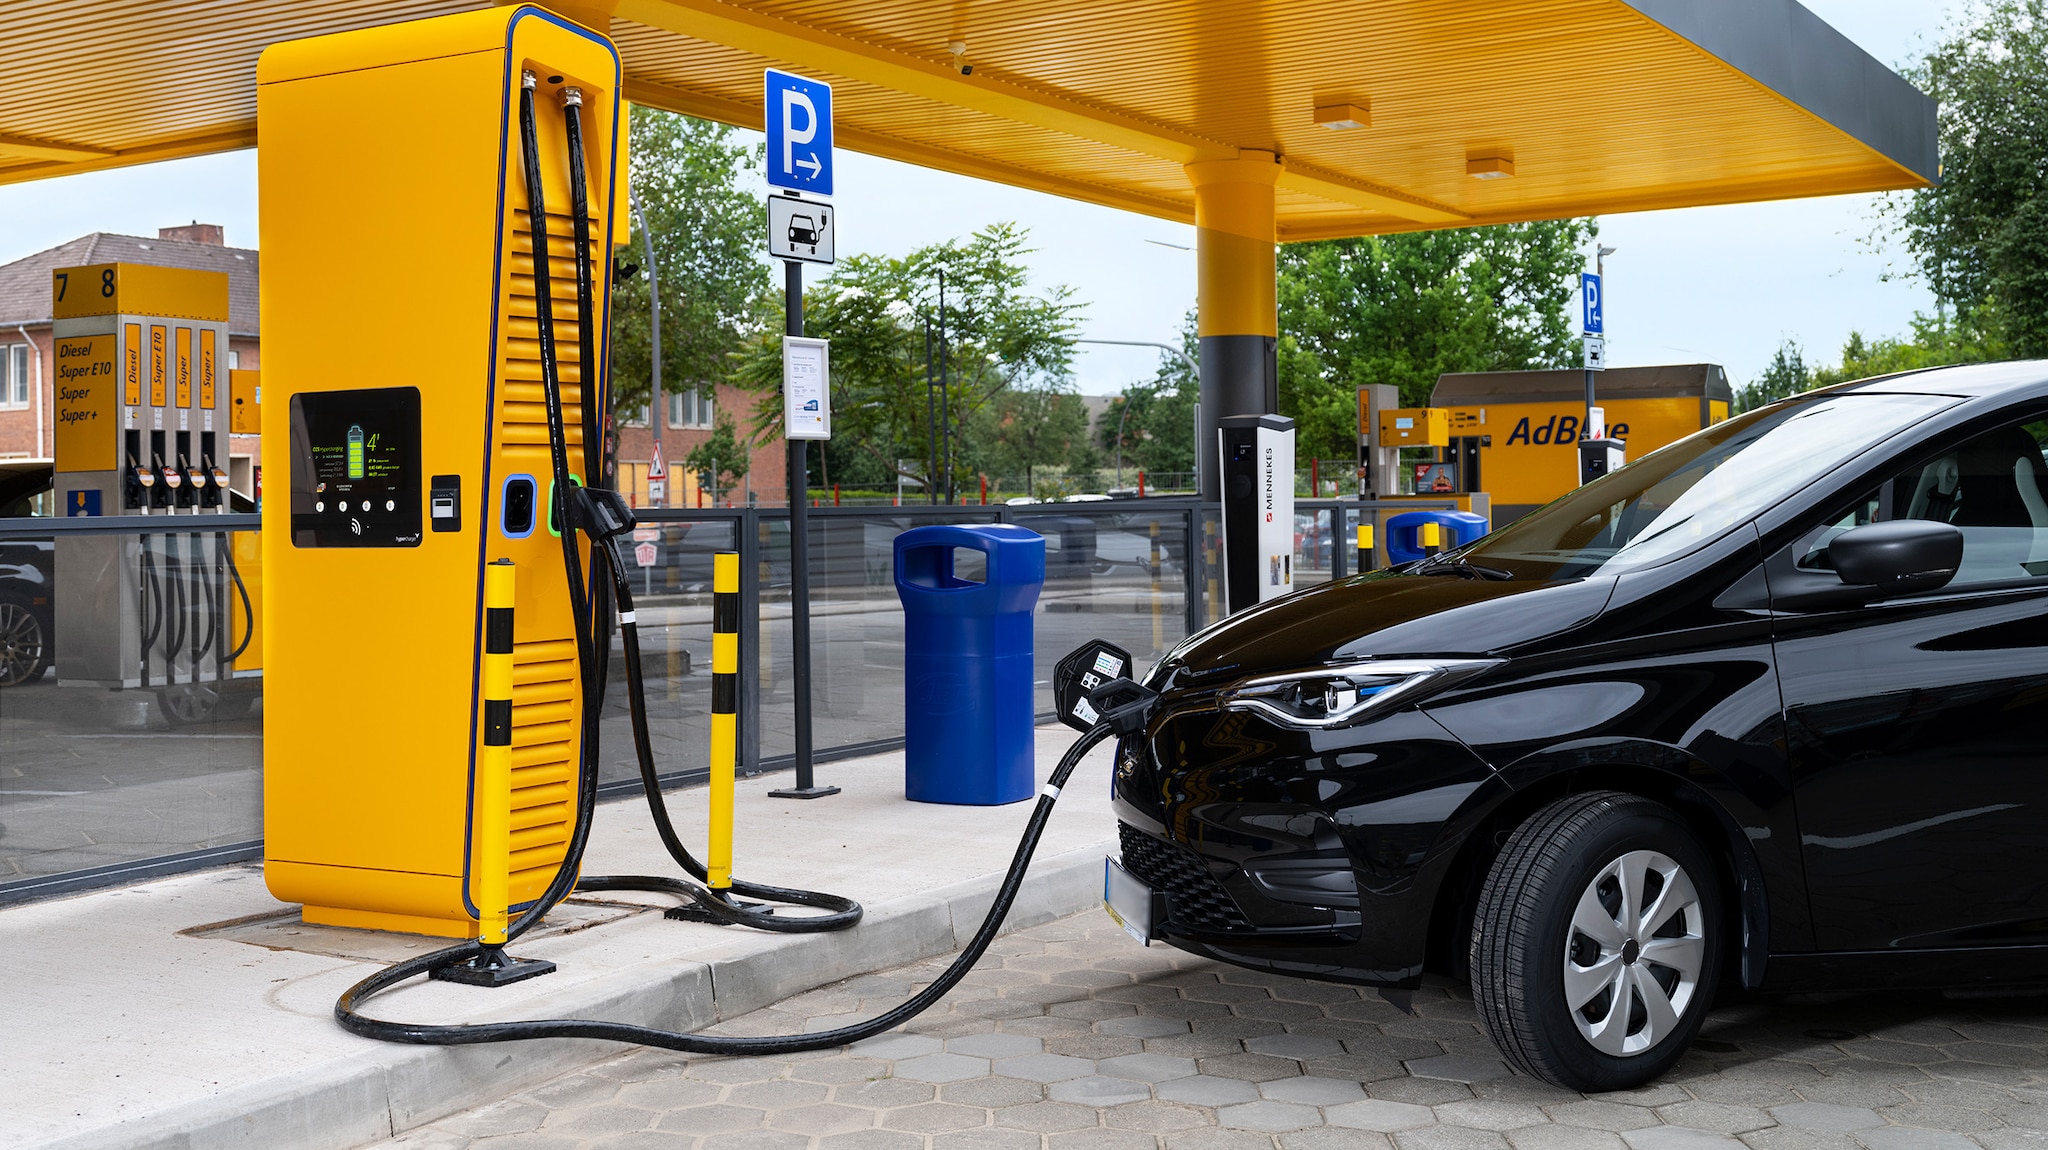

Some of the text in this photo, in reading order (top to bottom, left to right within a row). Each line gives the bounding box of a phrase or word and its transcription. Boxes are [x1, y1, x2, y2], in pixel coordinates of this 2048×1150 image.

[782, 88, 818, 174] P
[55, 269, 115, 302] 7 8
[1586, 280, 1598, 325] P
[60, 342, 92, 358] Diesel
[128, 348, 137, 384] Diesel
[59, 364, 90, 382] Super
[153, 353, 164, 385] Super
[179, 355, 189, 387] Super
[203, 357, 213, 388] Super
[59, 386, 90, 404] Super
[59, 408, 90, 426] Super
[1421, 410, 1428, 419] 9
[1265, 448, 1273, 510] MENNEKES
